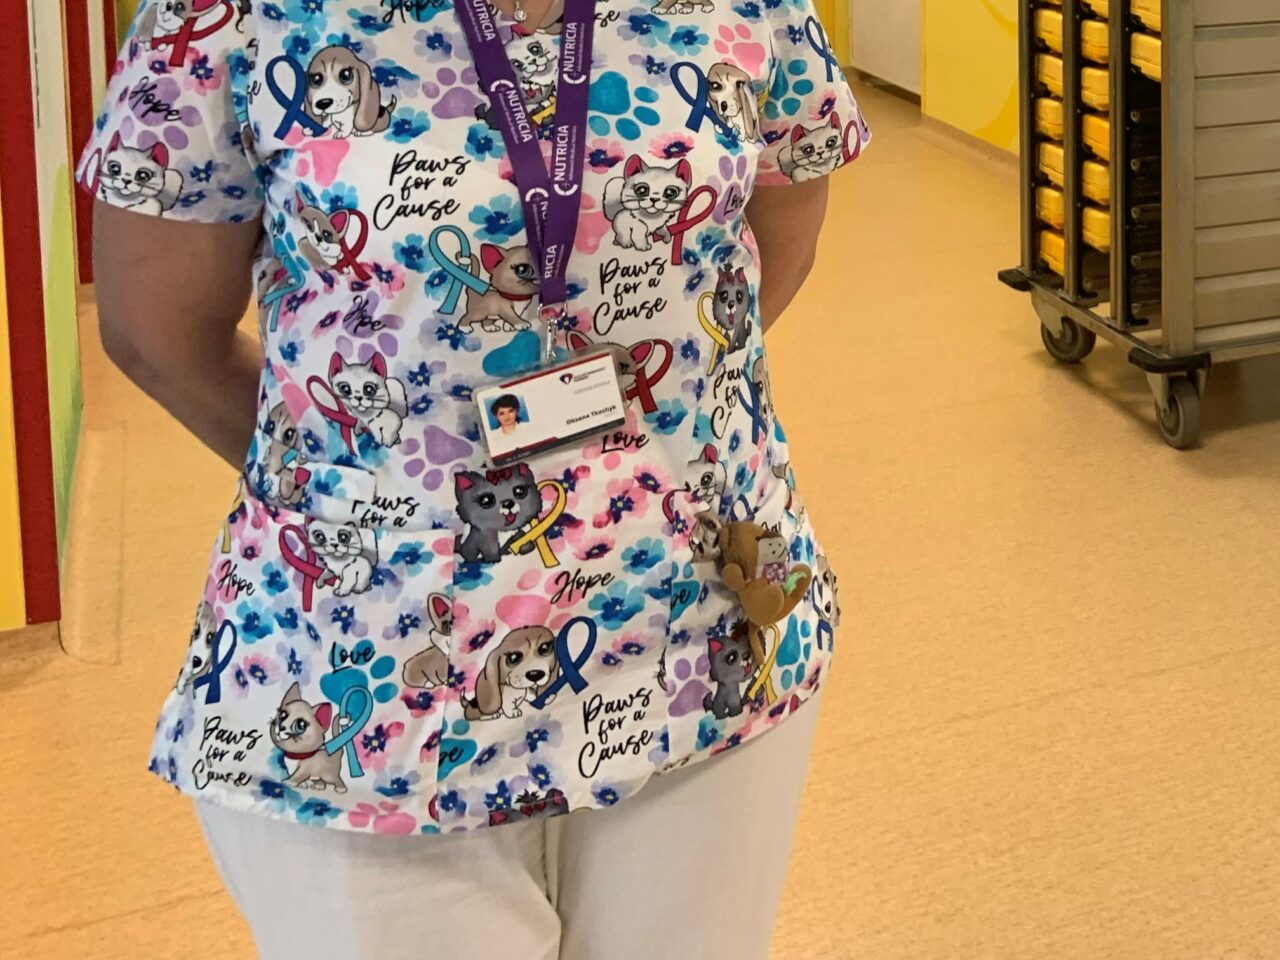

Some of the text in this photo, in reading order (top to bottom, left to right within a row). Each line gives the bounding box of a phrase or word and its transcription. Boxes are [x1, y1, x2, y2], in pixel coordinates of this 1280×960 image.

[563, 22, 577, 72] NUTRICIA
[129, 76, 182, 121] Hope
[507, 90, 533, 143] NUTRICIA
[389, 149, 471, 186] Paws
[554, 125, 569, 181] NUTRICIA
[401, 176, 458, 201] for a
[373, 194, 460, 231] Cause
[544, 244, 558, 279] RICIA
[600, 257, 667, 295] Paws
[613, 277, 661, 306] for a
[593, 297, 667, 336] Cause
[601, 431, 650, 454] Love
[360, 508, 388, 528] for
[393, 516, 407, 527] a
[217, 559, 256, 600] Hope
[550, 568, 615, 604] Hope
[333, 642, 376, 674] Love
[583, 687, 653, 734] Paws
[598, 710, 646, 745] for a
[199, 716, 263, 751] Paws
[205, 744, 247, 768] for a
[578, 729, 653, 778] Cause
